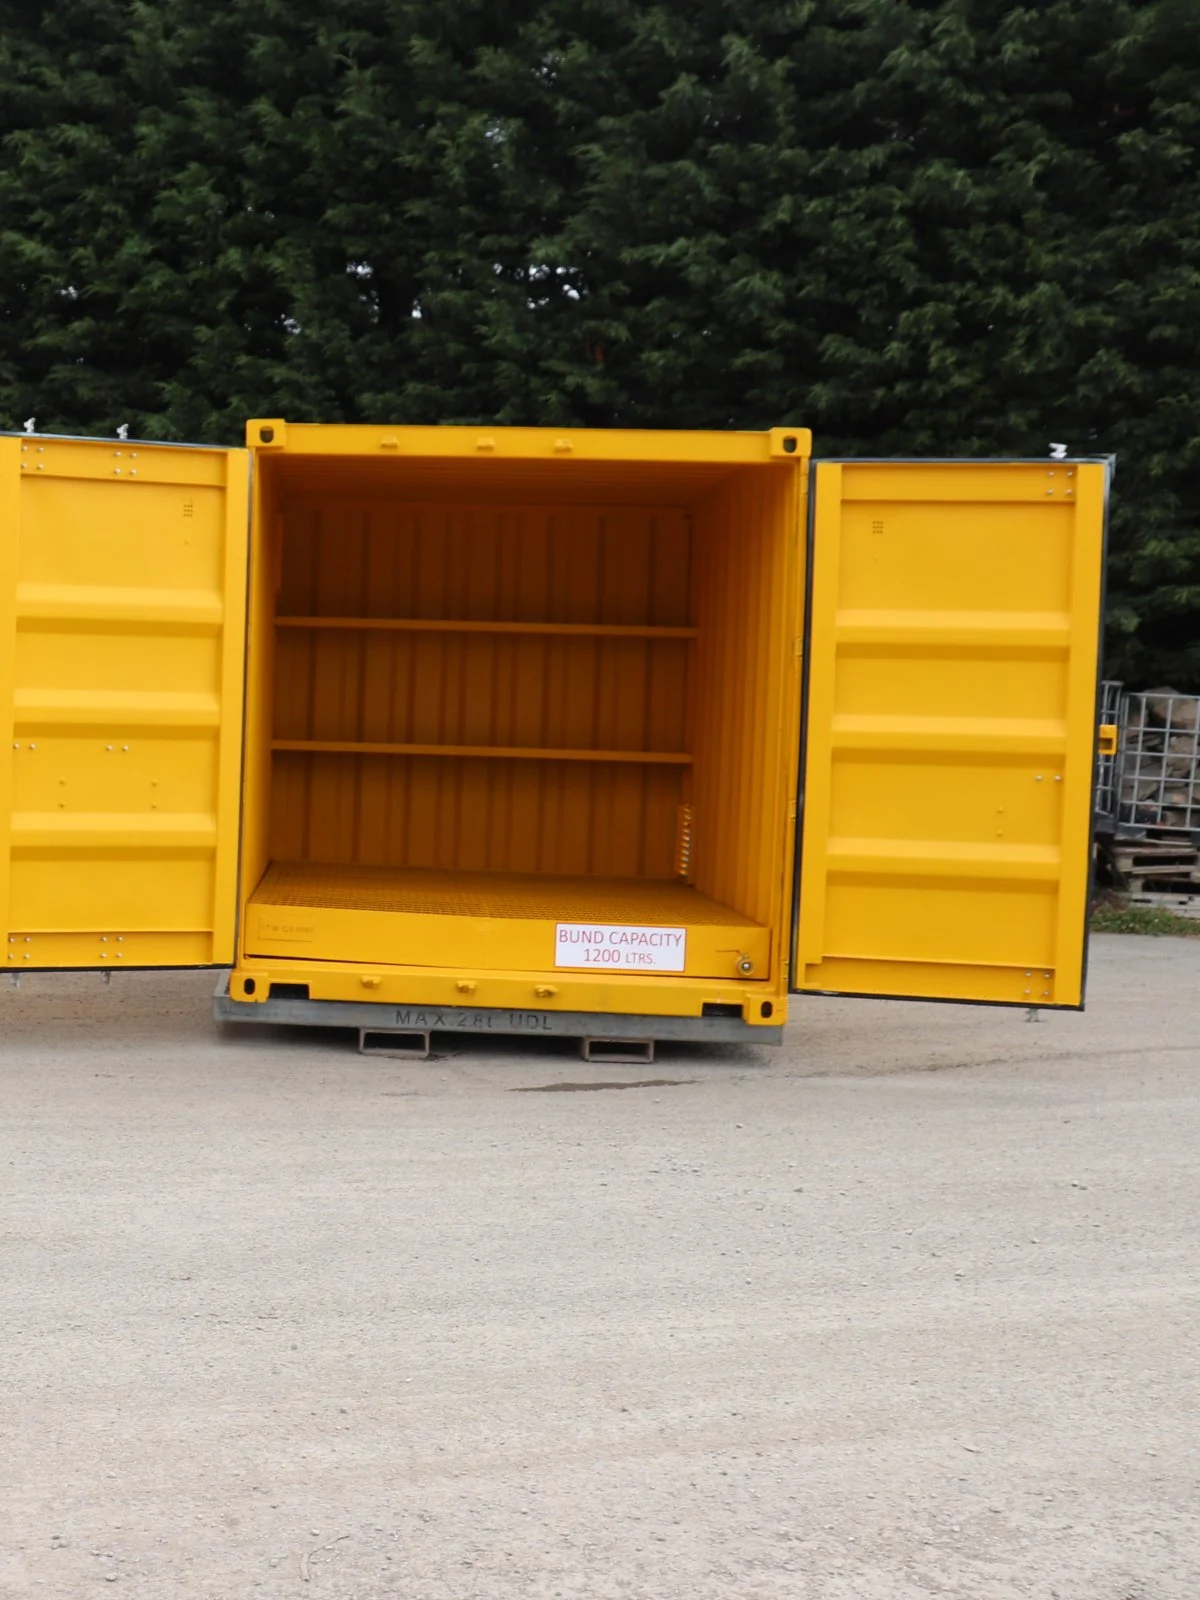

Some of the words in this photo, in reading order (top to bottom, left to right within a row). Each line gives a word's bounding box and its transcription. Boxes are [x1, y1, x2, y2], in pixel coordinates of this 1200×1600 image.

[558, 929, 604, 944] BUND
[608, 931, 683, 947] CAPACITY
[583, 948, 620, 963] 1200
[624, 953, 657, 965] LTRS.
